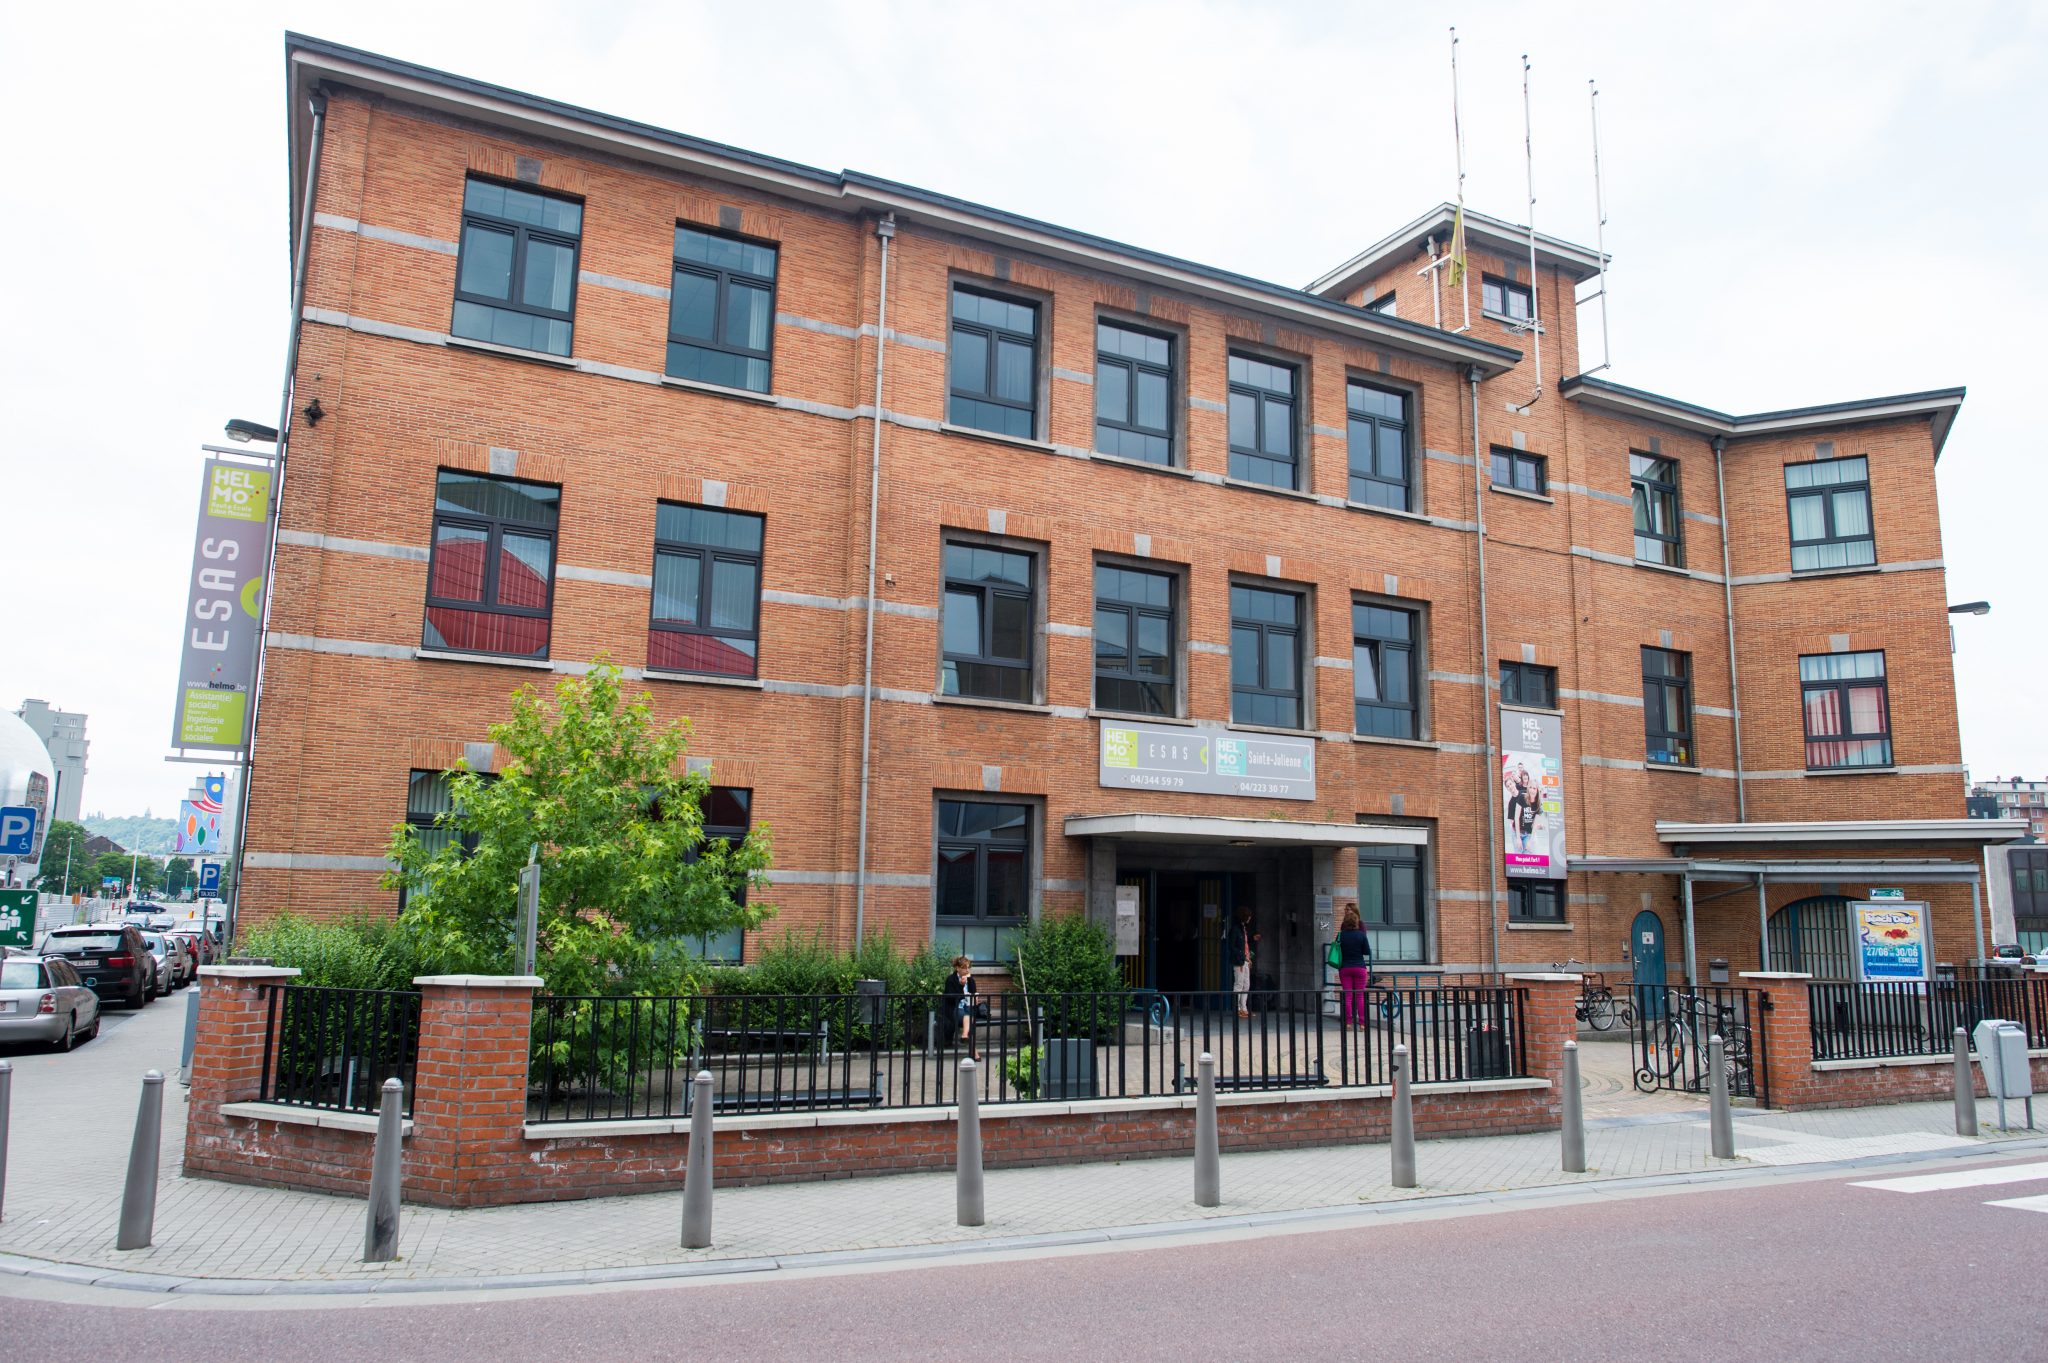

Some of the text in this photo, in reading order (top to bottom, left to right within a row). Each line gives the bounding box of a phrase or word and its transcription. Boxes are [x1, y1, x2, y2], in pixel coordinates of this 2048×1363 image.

[214, 468, 254, 489] HEL
[212, 485, 249, 504] MO
[191, 537, 240, 652] ESAS
[187, 680, 247, 691] www.helmo.be
[189, 692, 232, 702] Assistant(e)
[195, 725, 218, 733] action
[1522, 717, 1540, 730] HEL
[184, 734, 214, 742] sociales
[1106, 730, 1129, 744] HEL
[1522, 729, 1539, 741] MO
[1106, 743, 1127, 756] MO
[1149, 744, 1188, 760] ESAS
[1217, 739, 1239, 753] HEL
[1217, 752, 1237, 765] MO
[1248, 750, 1301, 768] Sainte-Julienne
[1130, 774, 1184, 786] 04/344 59 79
[1240, 782, 1289, 794] 04/223 30 77
[0, 815, 31, 846] P
[203, 868, 217, 885] P
[1866, 947, 1889, 957] 27/06
[1895, 947, 1919, 957] 30/06
